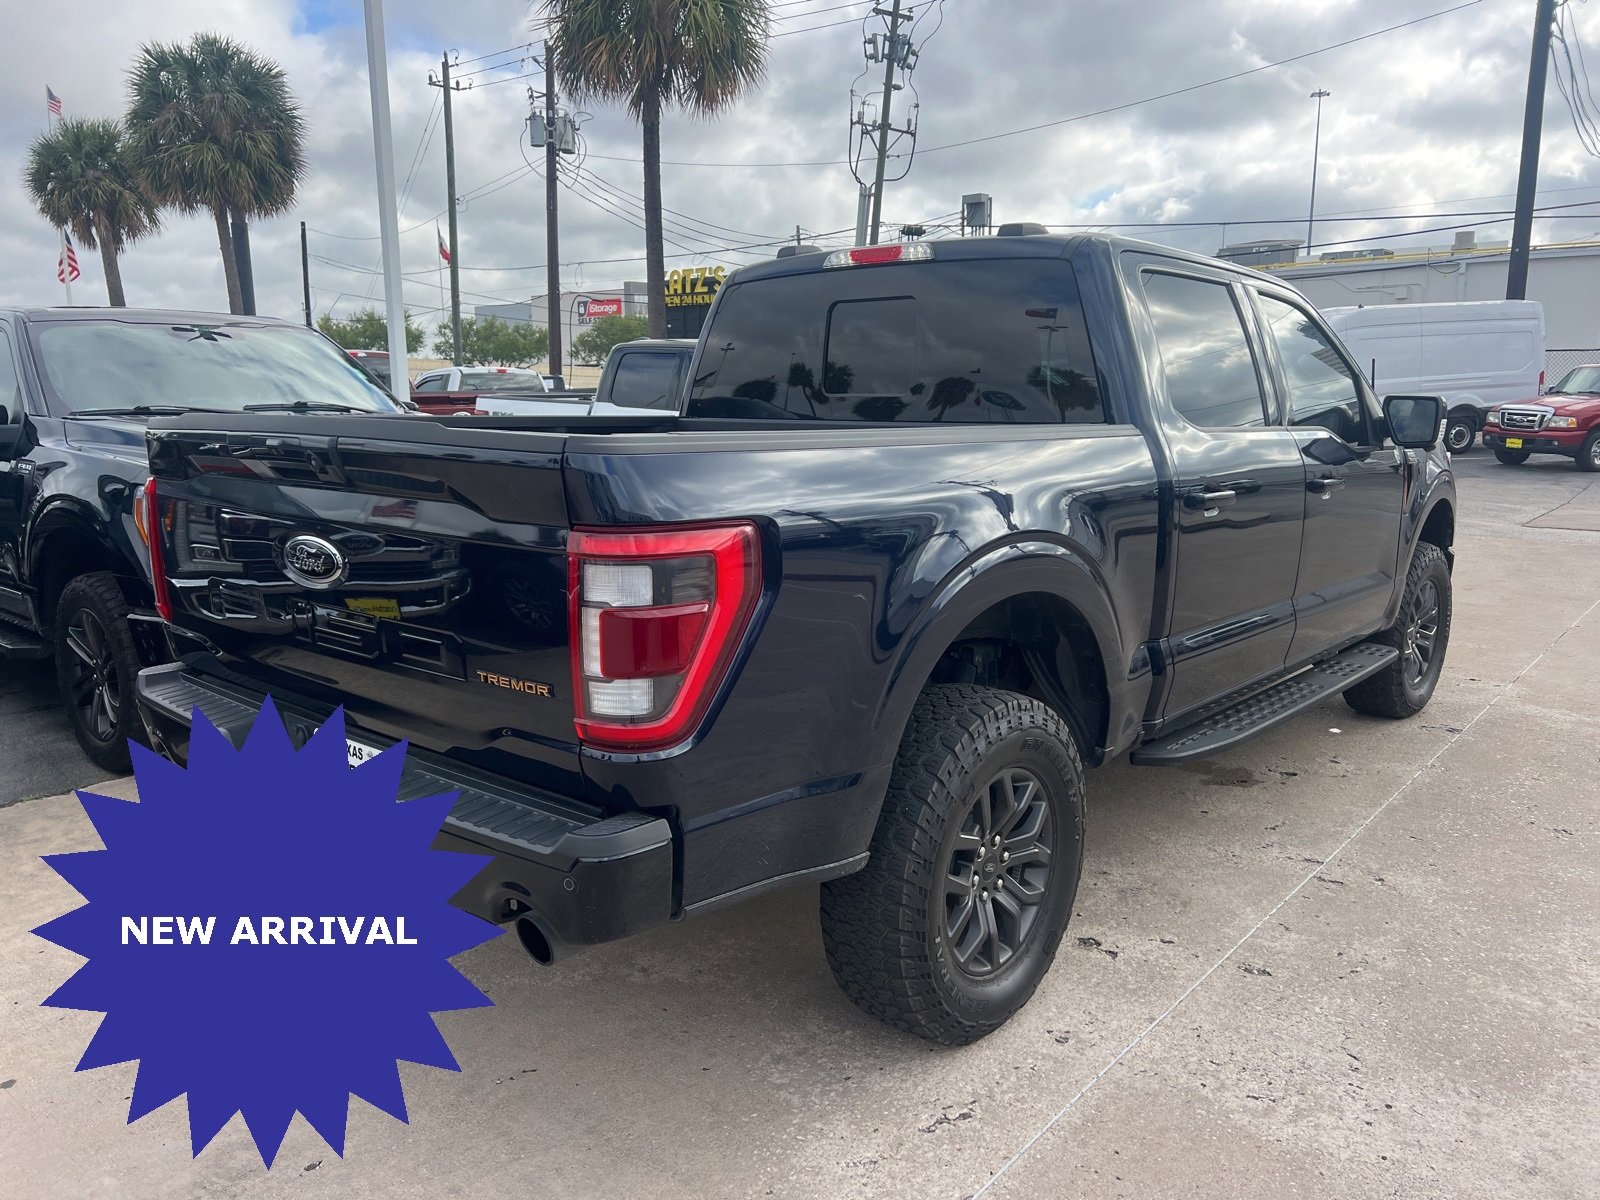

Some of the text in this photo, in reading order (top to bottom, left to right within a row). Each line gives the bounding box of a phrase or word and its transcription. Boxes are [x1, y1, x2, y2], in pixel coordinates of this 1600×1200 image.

[664, 266, 725, 294] ATZ'S
[589, 303, 618, 314] iStorage
[288, 545, 325, 573] Ford
[476, 670, 552, 698] TREMOR
